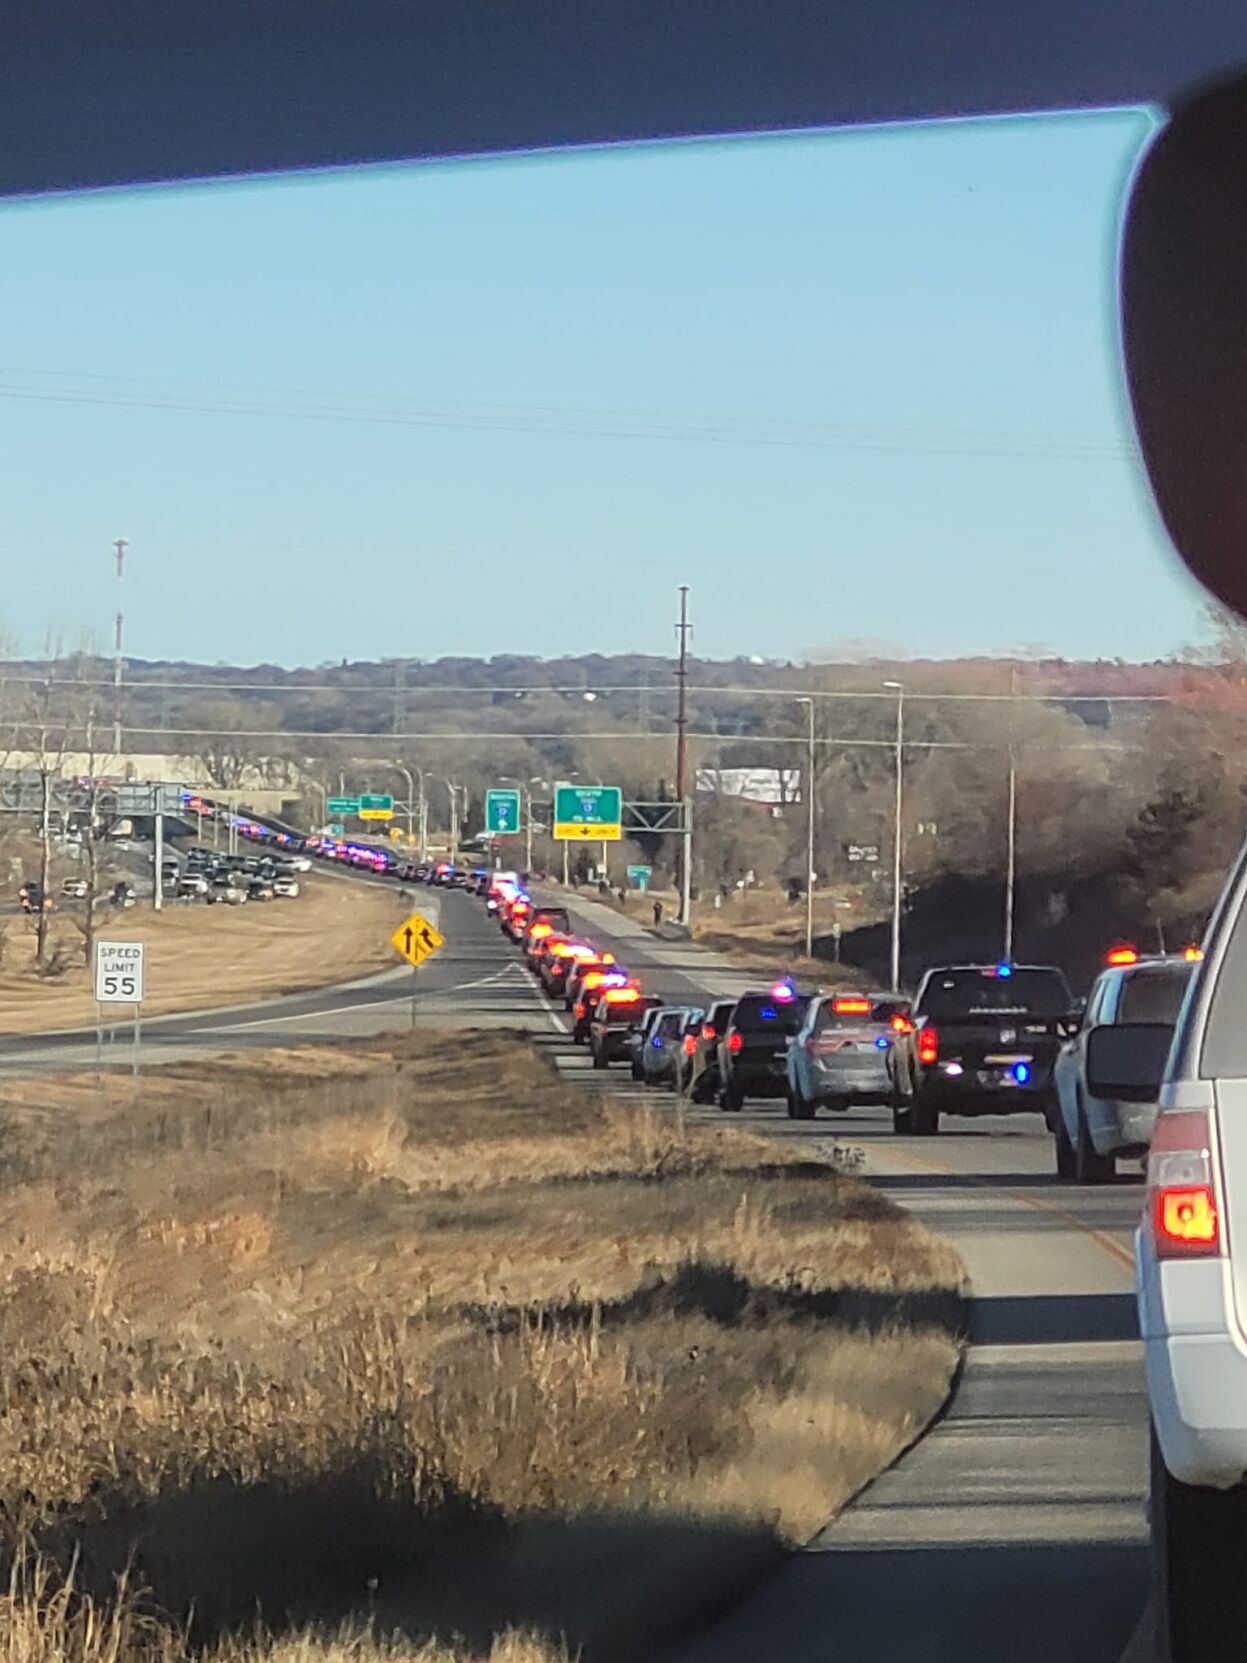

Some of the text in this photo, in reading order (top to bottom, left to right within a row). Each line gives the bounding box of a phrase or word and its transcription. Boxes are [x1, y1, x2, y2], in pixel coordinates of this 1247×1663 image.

[101, 948, 140, 958] SPEED
[104, 963, 134, 972] LIMIT
[104, 977, 135, 995] 55
